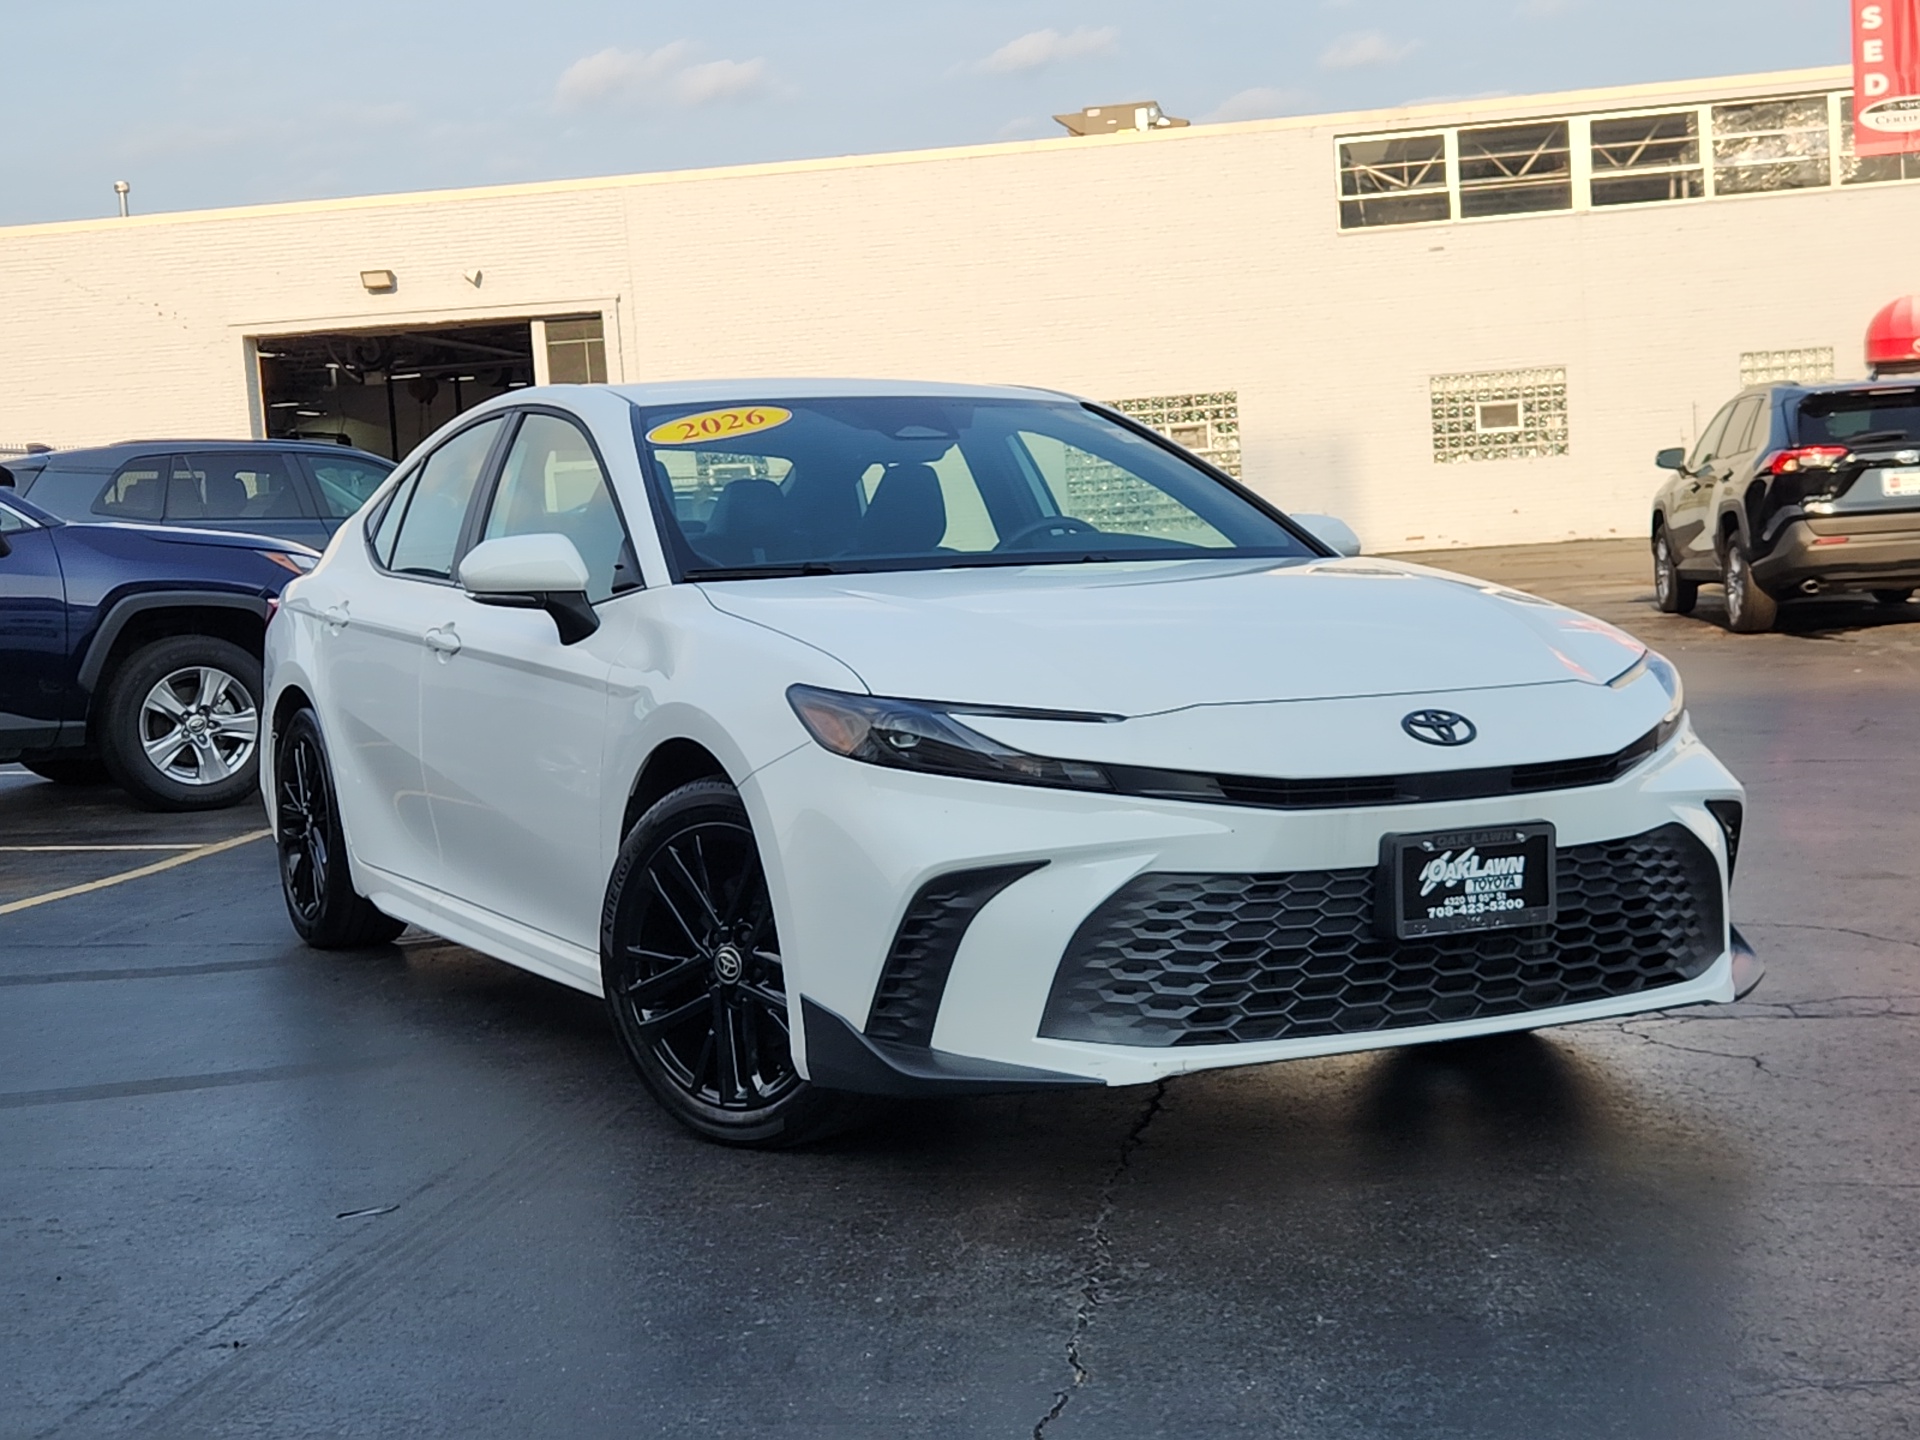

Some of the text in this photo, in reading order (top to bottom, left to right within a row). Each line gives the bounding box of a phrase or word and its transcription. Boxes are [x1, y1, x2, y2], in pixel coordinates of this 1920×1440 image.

[676, 409, 765, 440] 2026
[1436, 829, 1514, 845] OAK LAWN
[1471, 875, 1516, 892] TOYOTA
[1467, 894, 1477, 904] W
[1427, 898, 1525, 919] 708-423-5200
